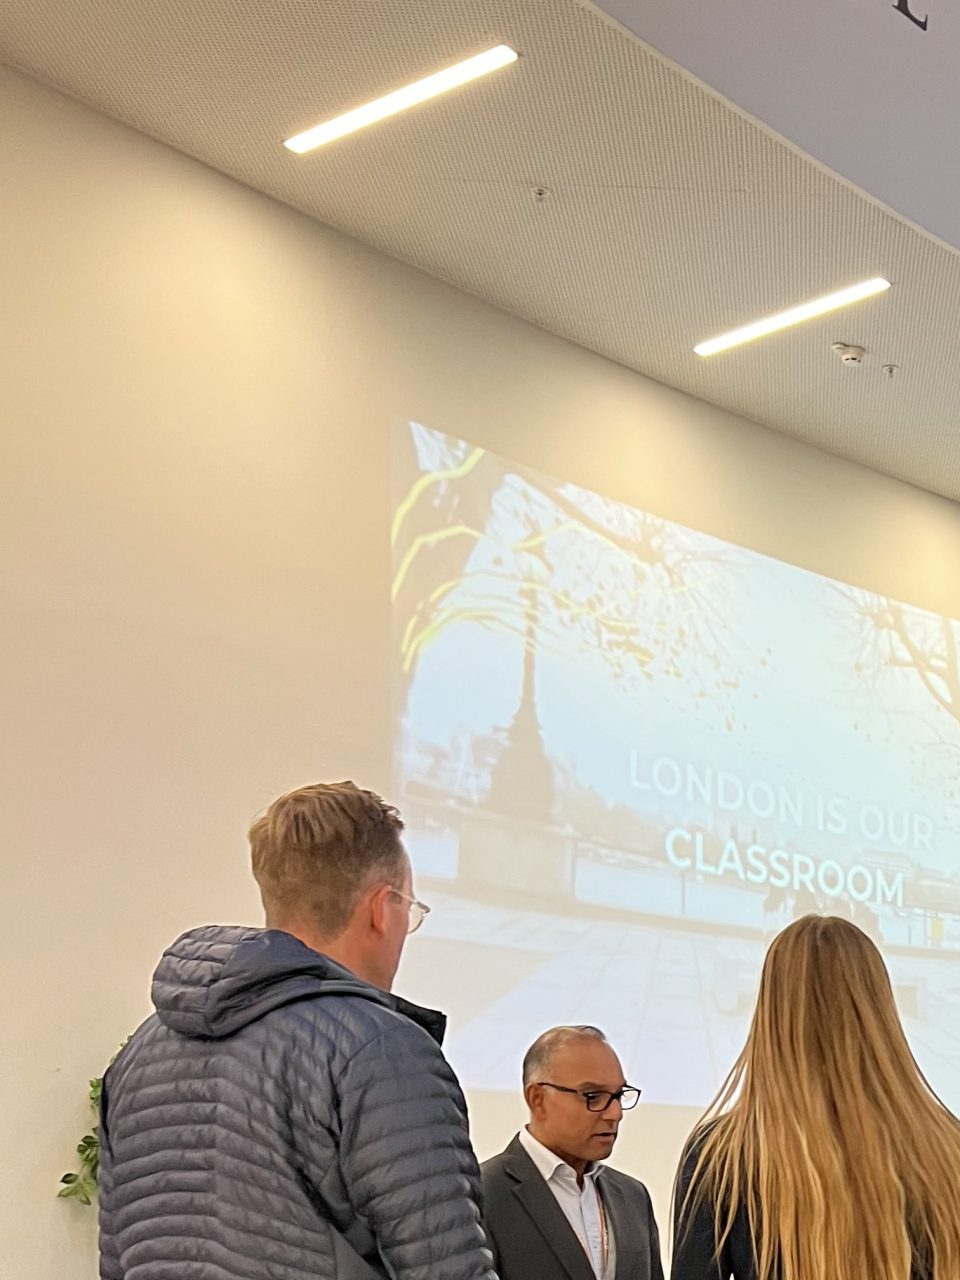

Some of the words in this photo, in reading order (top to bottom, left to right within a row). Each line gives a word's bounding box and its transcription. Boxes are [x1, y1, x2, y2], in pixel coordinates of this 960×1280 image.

[629, 749, 803, 828] LONDON
[816, 794, 848, 836] IS
[859, 805, 935, 852] OUR
[664, 827, 904, 908] CLASSROOM
